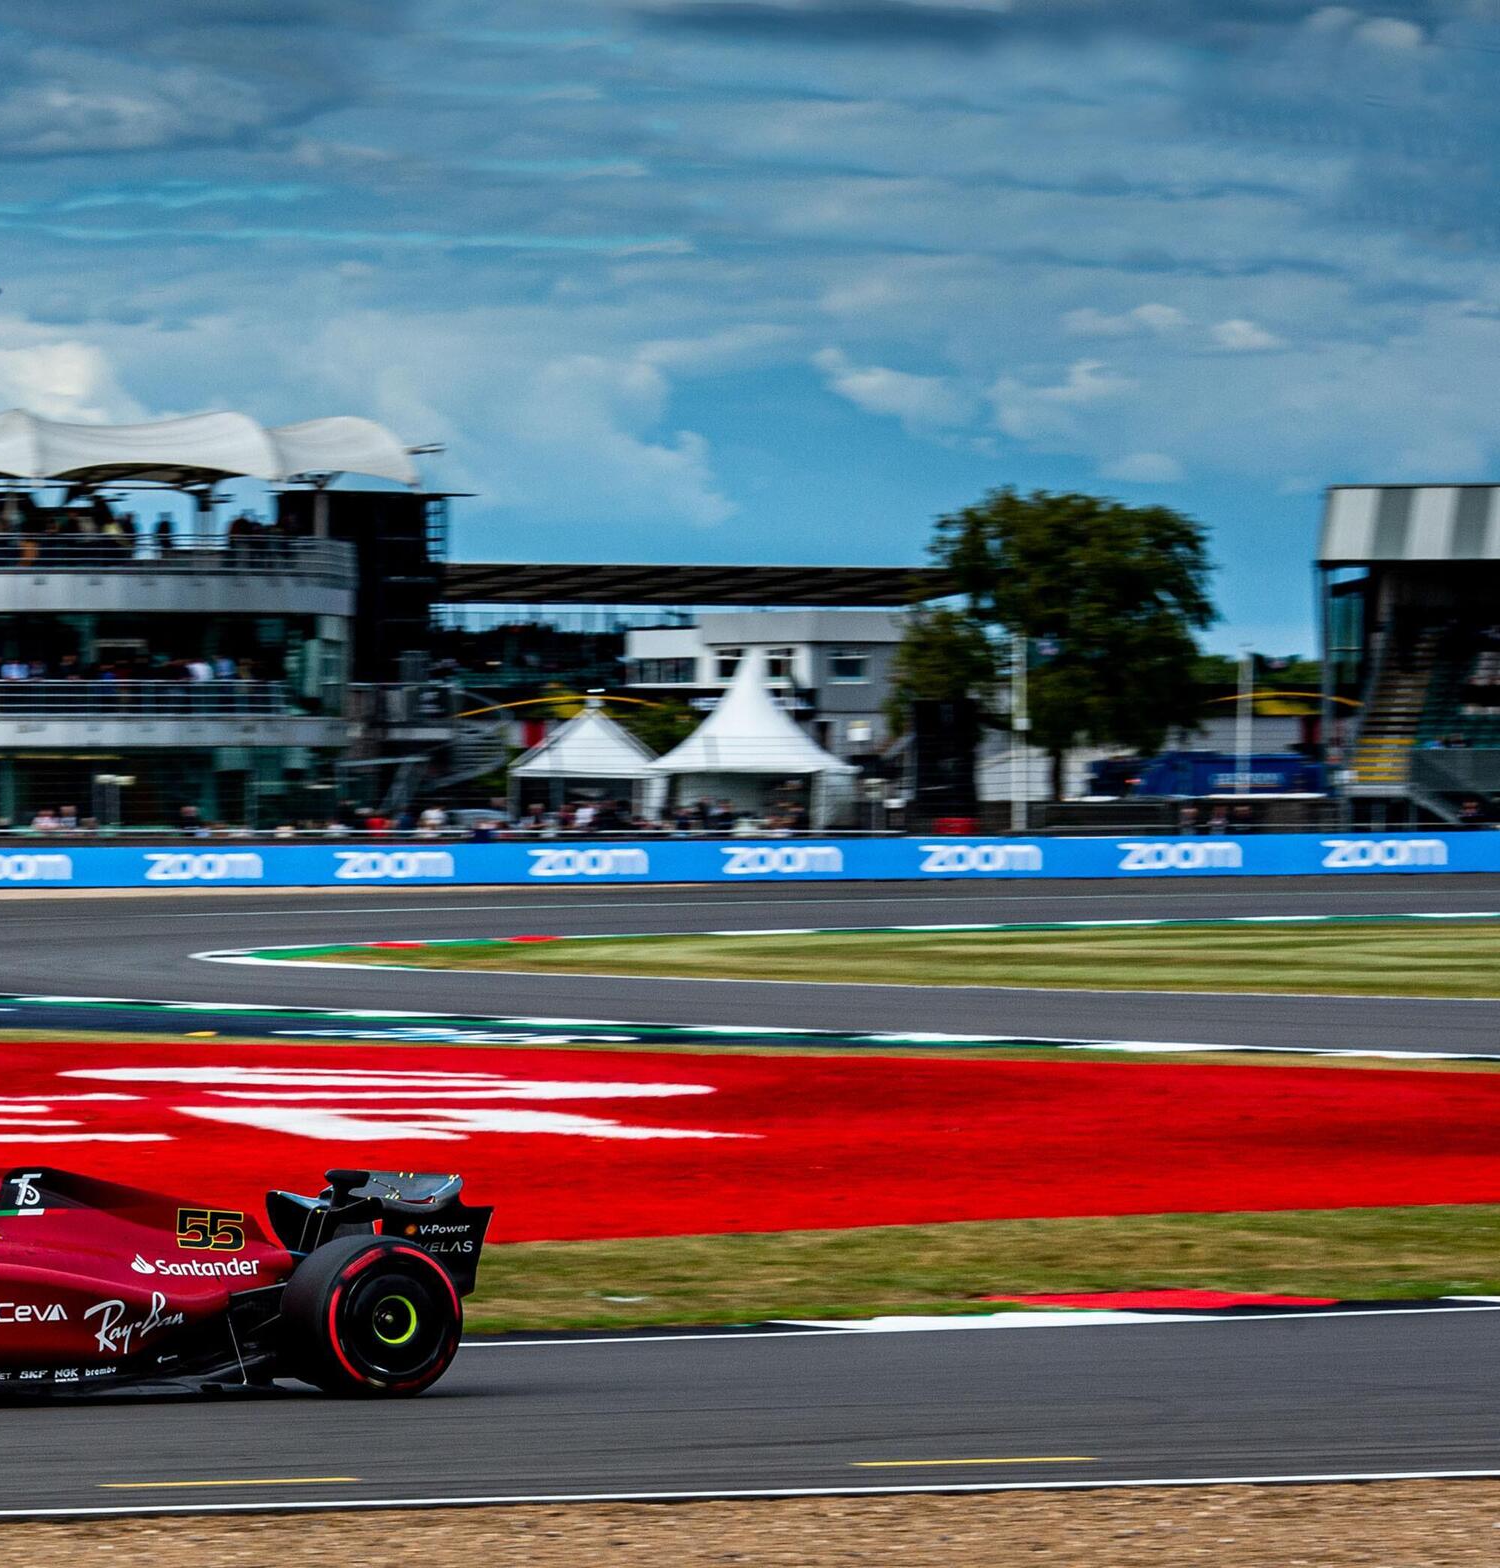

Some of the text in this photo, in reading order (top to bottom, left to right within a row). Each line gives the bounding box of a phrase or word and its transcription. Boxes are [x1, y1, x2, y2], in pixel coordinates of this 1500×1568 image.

[145, 854, 263, 880] zoom
[335, 852, 454, 878] zoom
[530, 849, 648, 876] zoom
[722, 847, 842, 874] zoom
[920, 845, 1042, 872] zoom
[1118, 842, 1242, 869] zoom
[1322, 840, 1448, 867] zoom
[176, 1207, 245, 1252] 55
[419, 1224, 471, 1235] V-Power
[155, 1257, 260, 1277] Santander
[19, 1370, 49, 1379] SKF
[54, 1368, 79, 1378] NGK
